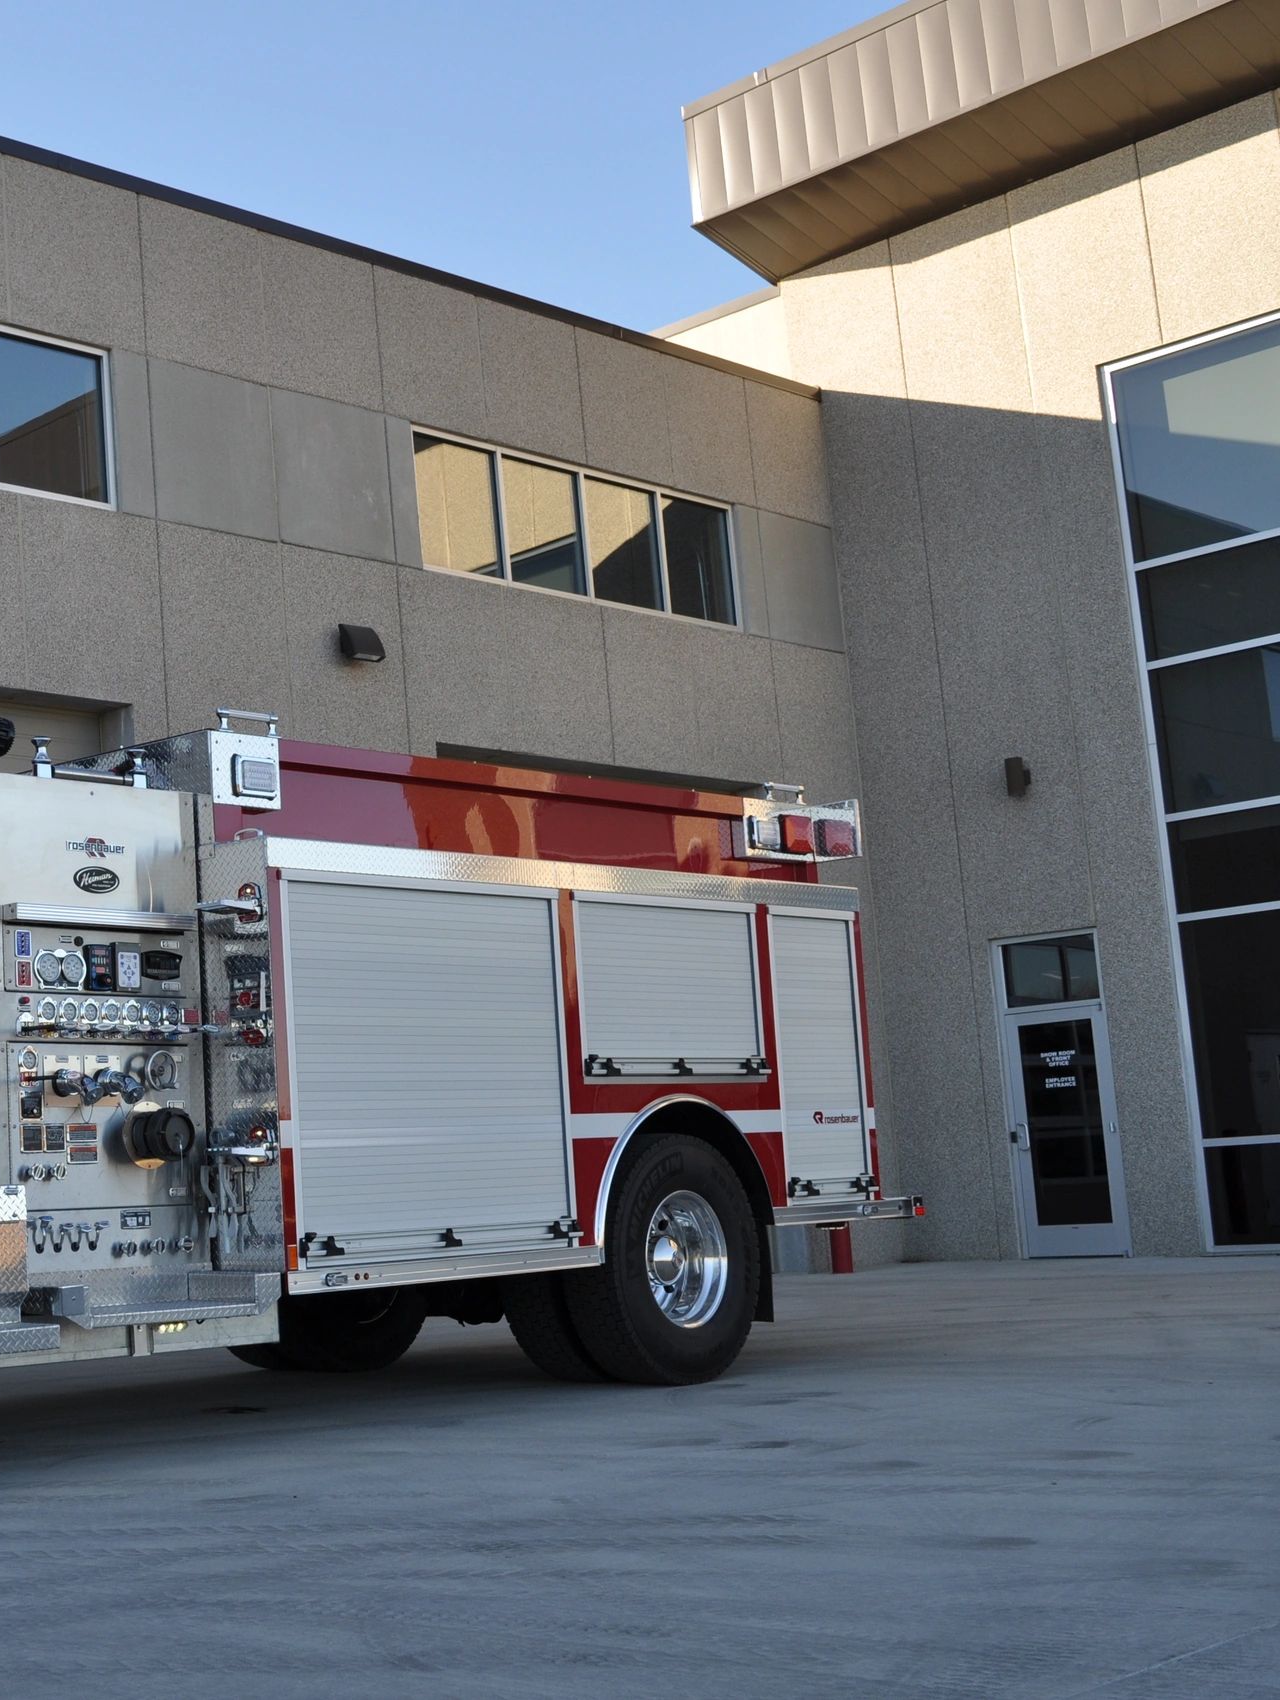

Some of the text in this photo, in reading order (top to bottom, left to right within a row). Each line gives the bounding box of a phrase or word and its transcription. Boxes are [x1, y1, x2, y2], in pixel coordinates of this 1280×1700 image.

[80, 871, 113, 887] Heiman
[824, 1113, 859, 1124] rosenbauer
[629, 1150, 685, 1244] MICHELIN
